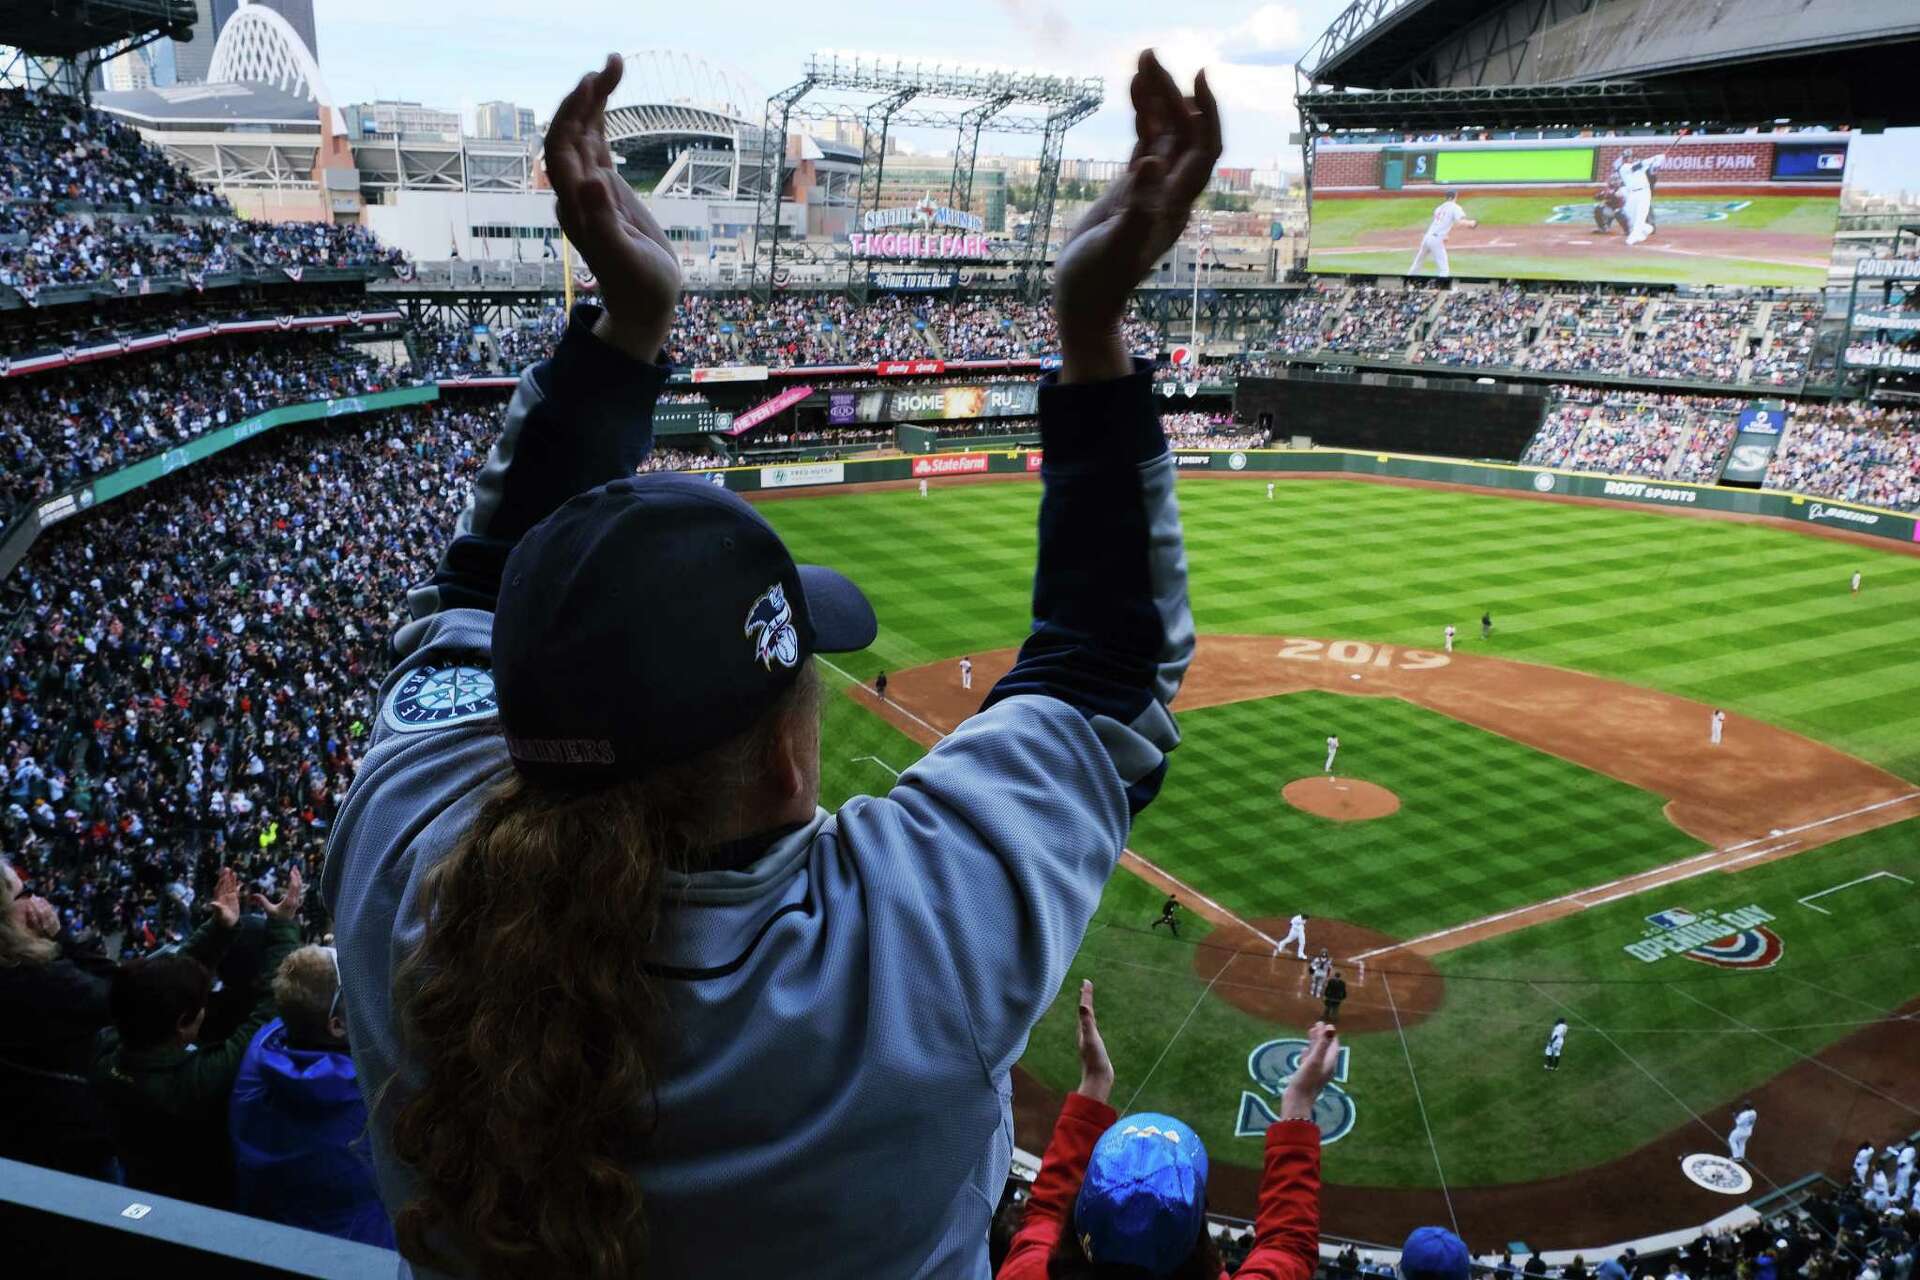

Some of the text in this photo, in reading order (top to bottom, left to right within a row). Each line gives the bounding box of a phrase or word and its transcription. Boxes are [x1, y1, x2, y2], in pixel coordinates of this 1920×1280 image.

[1716, 154, 1757, 169] PARK
[850, 233, 990, 257] T-MOBILE PARK
[885, 273, 952, 288] TRUE TO THE BLUE
[898, 395, 944, 411] HOME
[1604, 481, 1696, 502] ROOT SPORTS
[1278, 638, 1450, 670] 2019
